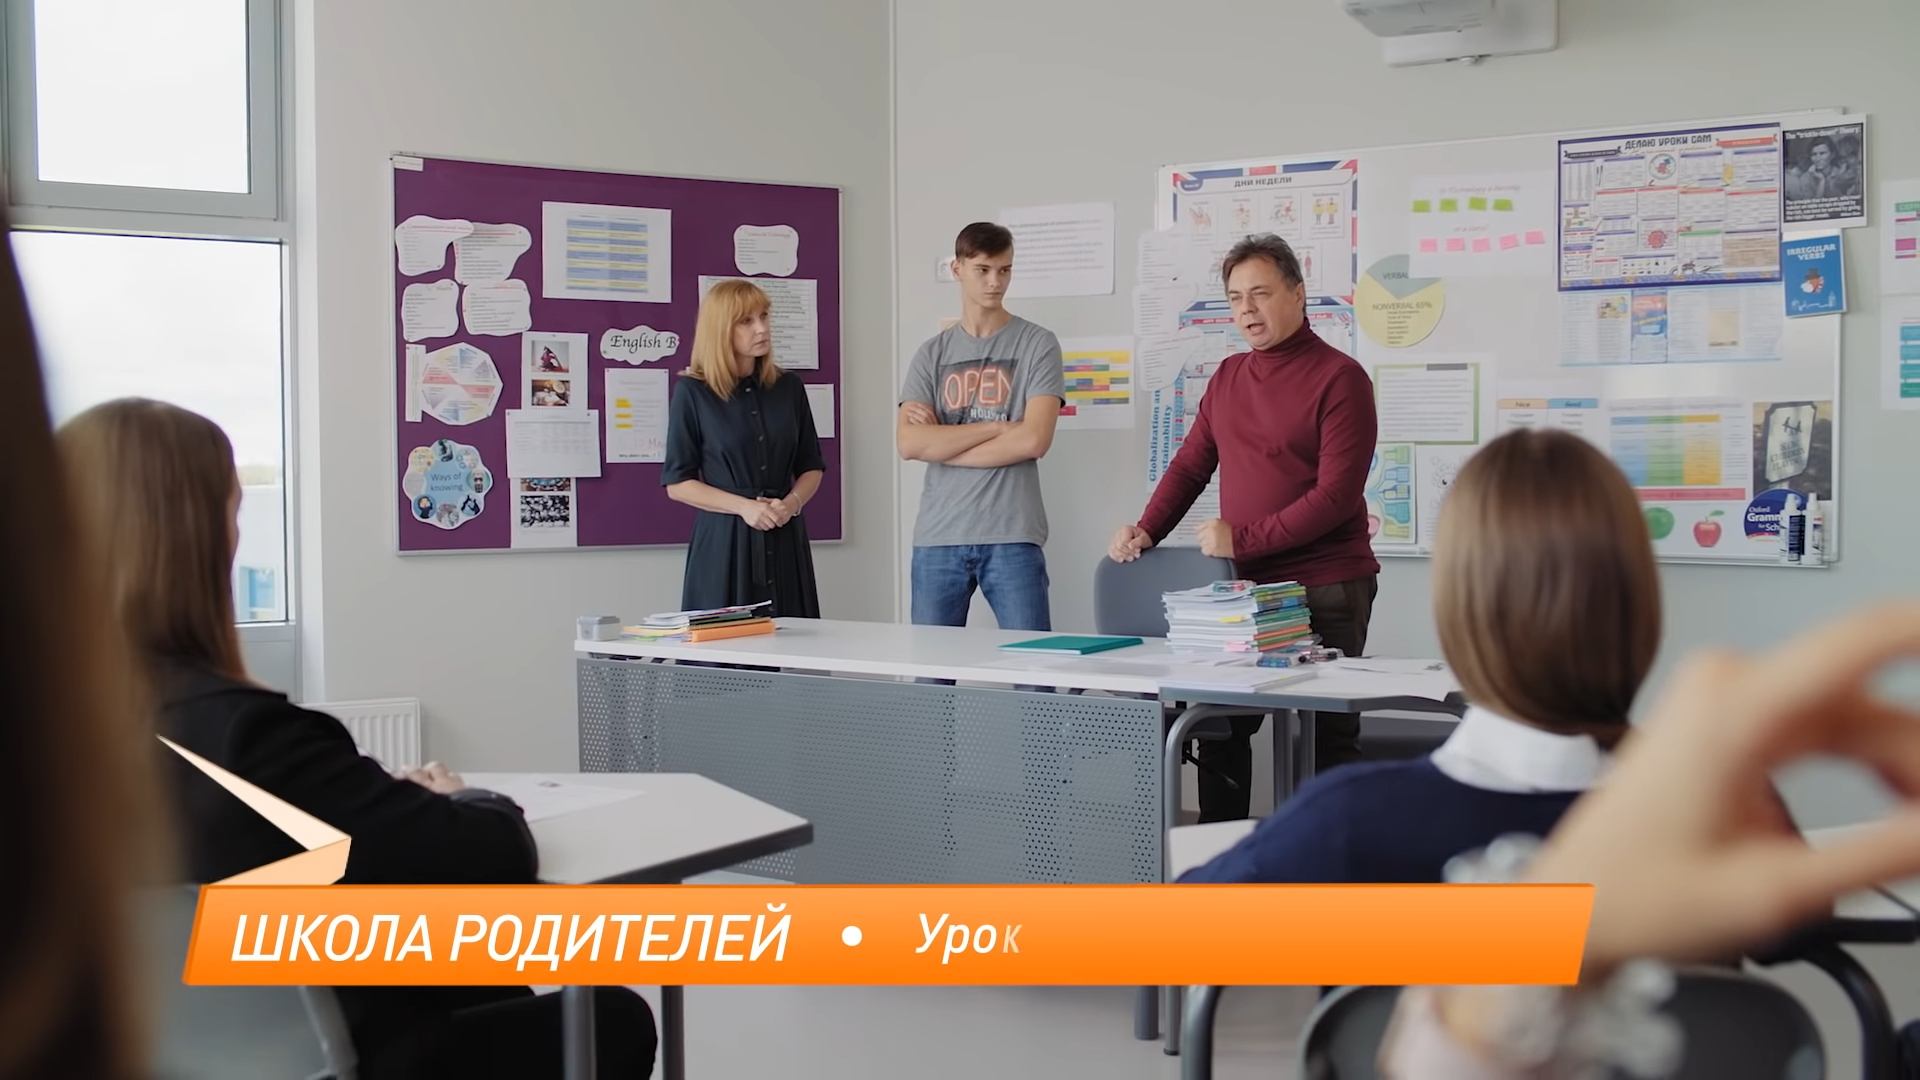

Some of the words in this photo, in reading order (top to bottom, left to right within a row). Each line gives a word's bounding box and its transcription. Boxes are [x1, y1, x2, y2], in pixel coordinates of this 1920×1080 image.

[1625, 138, 1656, 150] ДЕЛАЮ
[1658, 136, 1688, 147] УРОКИ
[1691, 134, 1712, 144] САМ
[1234, 179, 1254, 188] ДНИ
[1255, 176, 1292, 186] НЕДЕЛИ
[1787, 244, 1836, 255] IRREGULAR
[1797, 252, 1825, 260] VERBS
[1372, 302, 1415, 310] NONVERBAL
[610, 332, 661, 354] English
[666, 336, 677, 349] B
[945, 368, 1011, 409] OPEN
[1149, 406, 1160, 481] Globalization
[1162, 404, 1173, 473] stainability
[453, 472, 462, 480] of
[430, 483, 463, 492] knowing
[1747, 512, 1781, 522] Gramm
[1765, 523, 1780, 531] Sch
